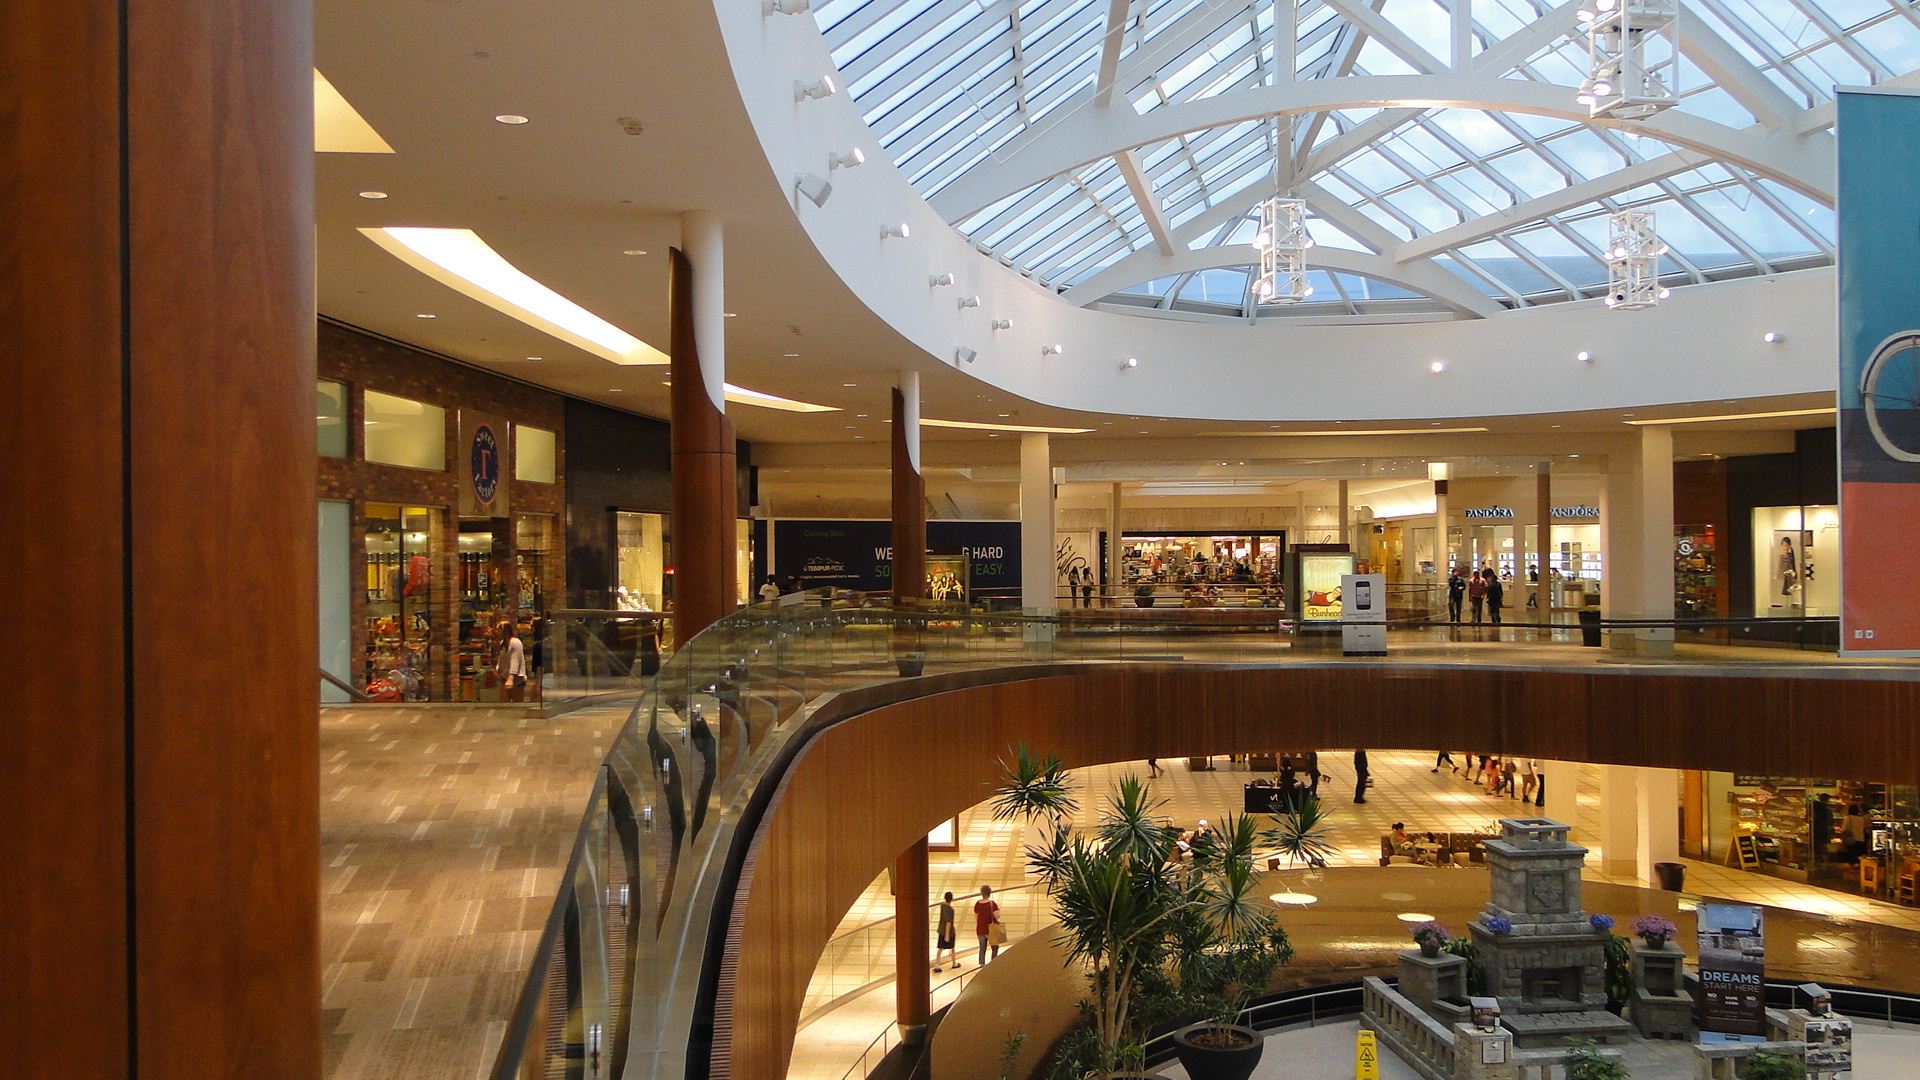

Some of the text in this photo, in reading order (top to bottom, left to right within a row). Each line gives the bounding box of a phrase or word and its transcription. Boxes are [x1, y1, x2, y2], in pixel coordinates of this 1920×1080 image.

[1466, 505, 1513, 518] PANDORA
[1550, 505, 1600, 517] ANDORA
[972, 546, 1003, 560] HARD
[875, 564, 890, 577] SO
[976, 563, 1005, 576] EASY.
[1703, 971, 1760, 985] DREAMS
[1703, 981, 1760, 993] START HERE
